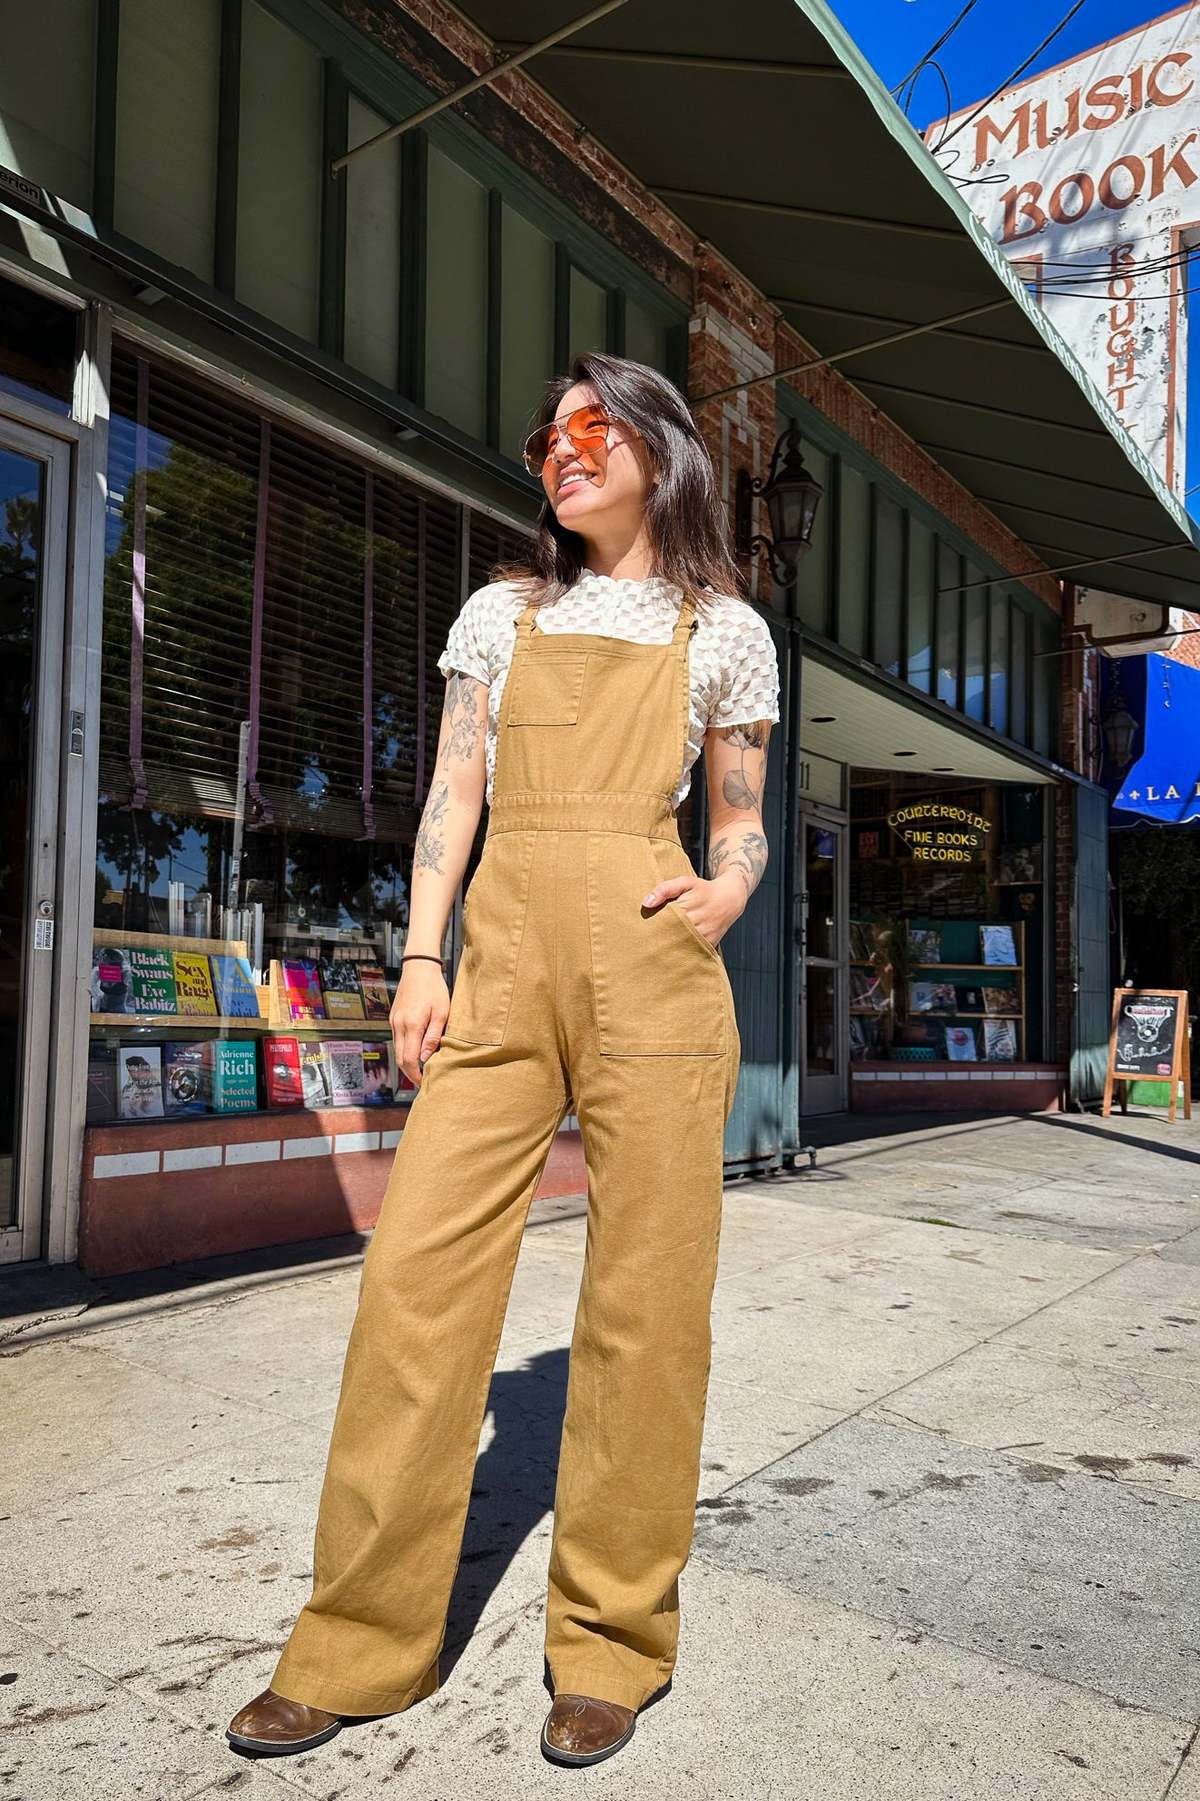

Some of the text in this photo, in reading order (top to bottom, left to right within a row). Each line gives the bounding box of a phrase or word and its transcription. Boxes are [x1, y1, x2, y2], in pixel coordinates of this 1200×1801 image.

[971, 52, 1194, 172] MUSIC
[1106, 243, 1139, 412] BOUGHT
[904, 830, 978, 846] FINE BOOKS
[913, 847, 972, 862] RECORDS
[131, 951, 169, 966] Black
[131, 966, 174, 979] Swans
[141, 984, 166, 997] Eve
[135, 997, 177, 1012] Babitz
[220, 1050, 254, 1058] Adrienne
[220, 1059, 254, 1075] Rich
[220, 1098, 256, 1108] Poems
